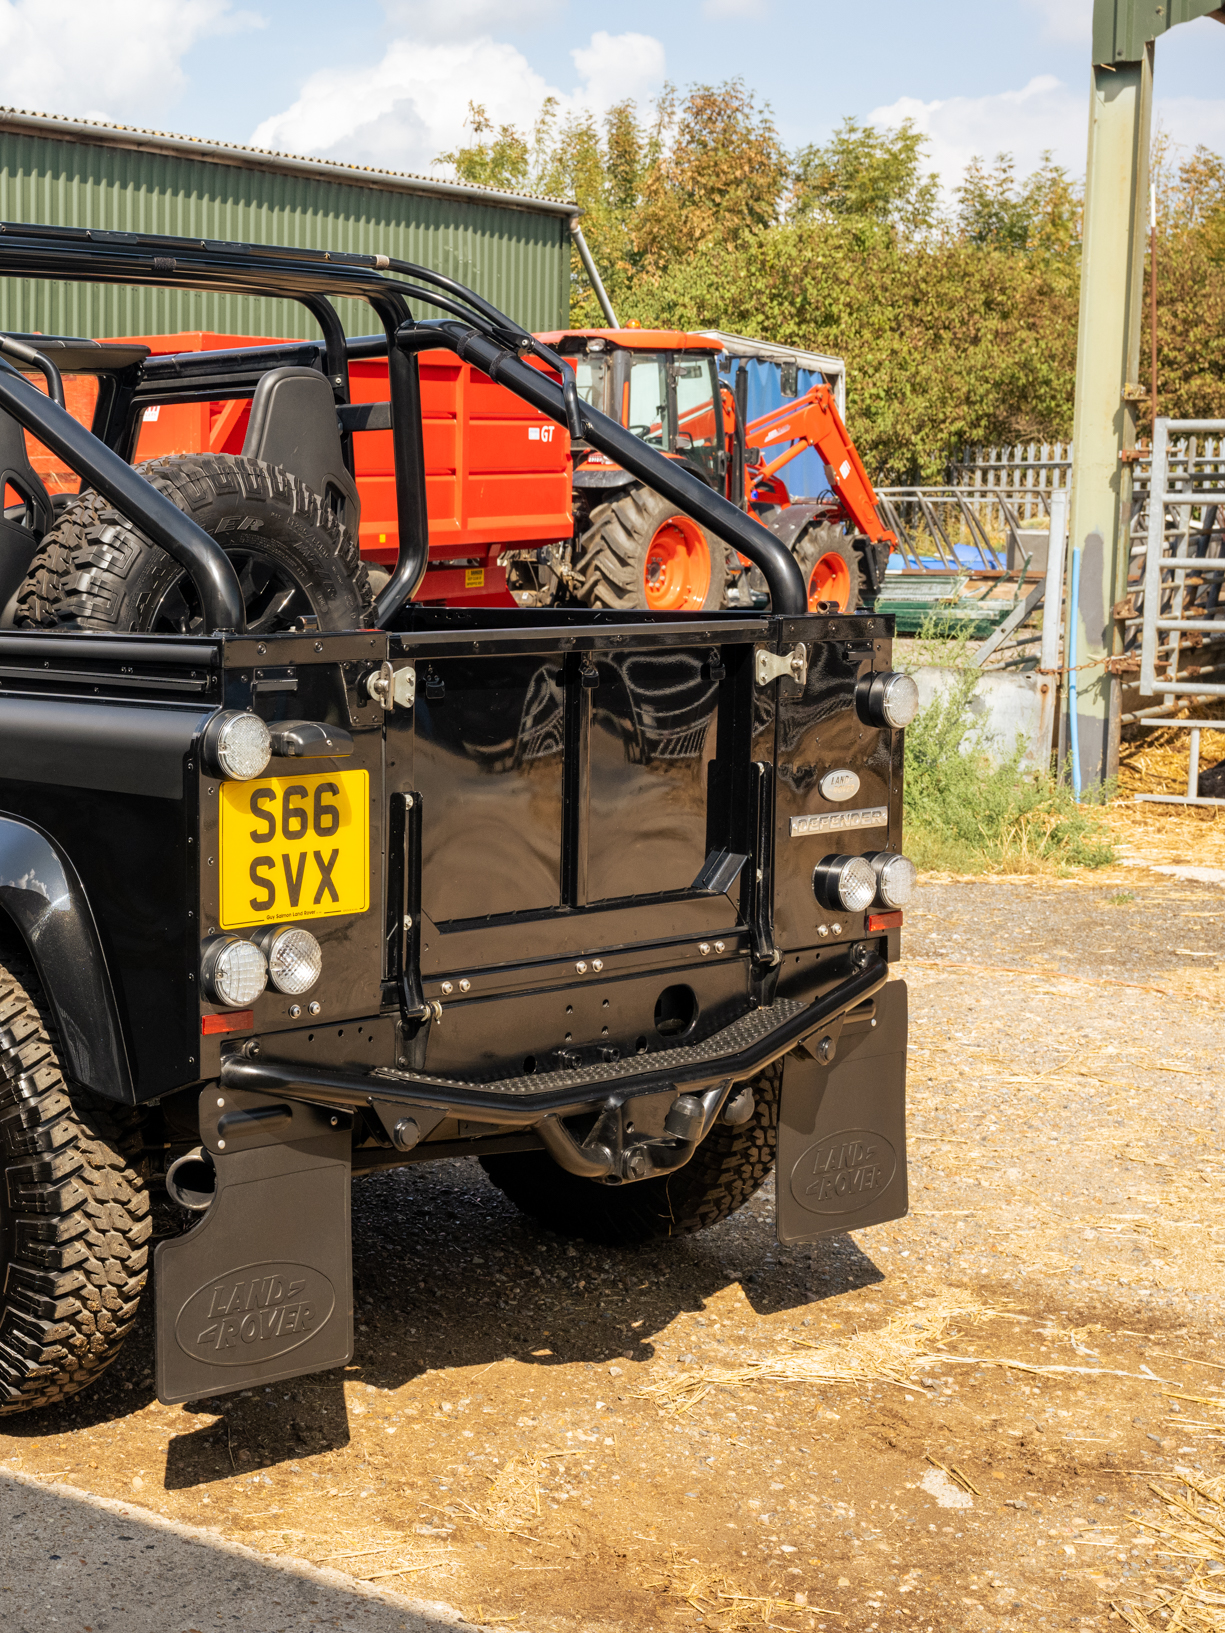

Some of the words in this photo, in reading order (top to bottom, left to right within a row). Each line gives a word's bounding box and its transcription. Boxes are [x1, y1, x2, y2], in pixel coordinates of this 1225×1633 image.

[541, 425, 555, 442] GT
[830, 775, 853, 785] LAND
[832, 783, 855, 793] ROVER
[249, 782, 340, 844] S66
[797, 810, 882, 833] DEFENDER
[249, 848, 340, 912] SVX
[813, 1141, 868, 1175] LAND
[817, 1163, 882, 1201] ROVER
[207, 1274, 290, 1319] LAND
[214, 1300, 317, 1350] ROVER
